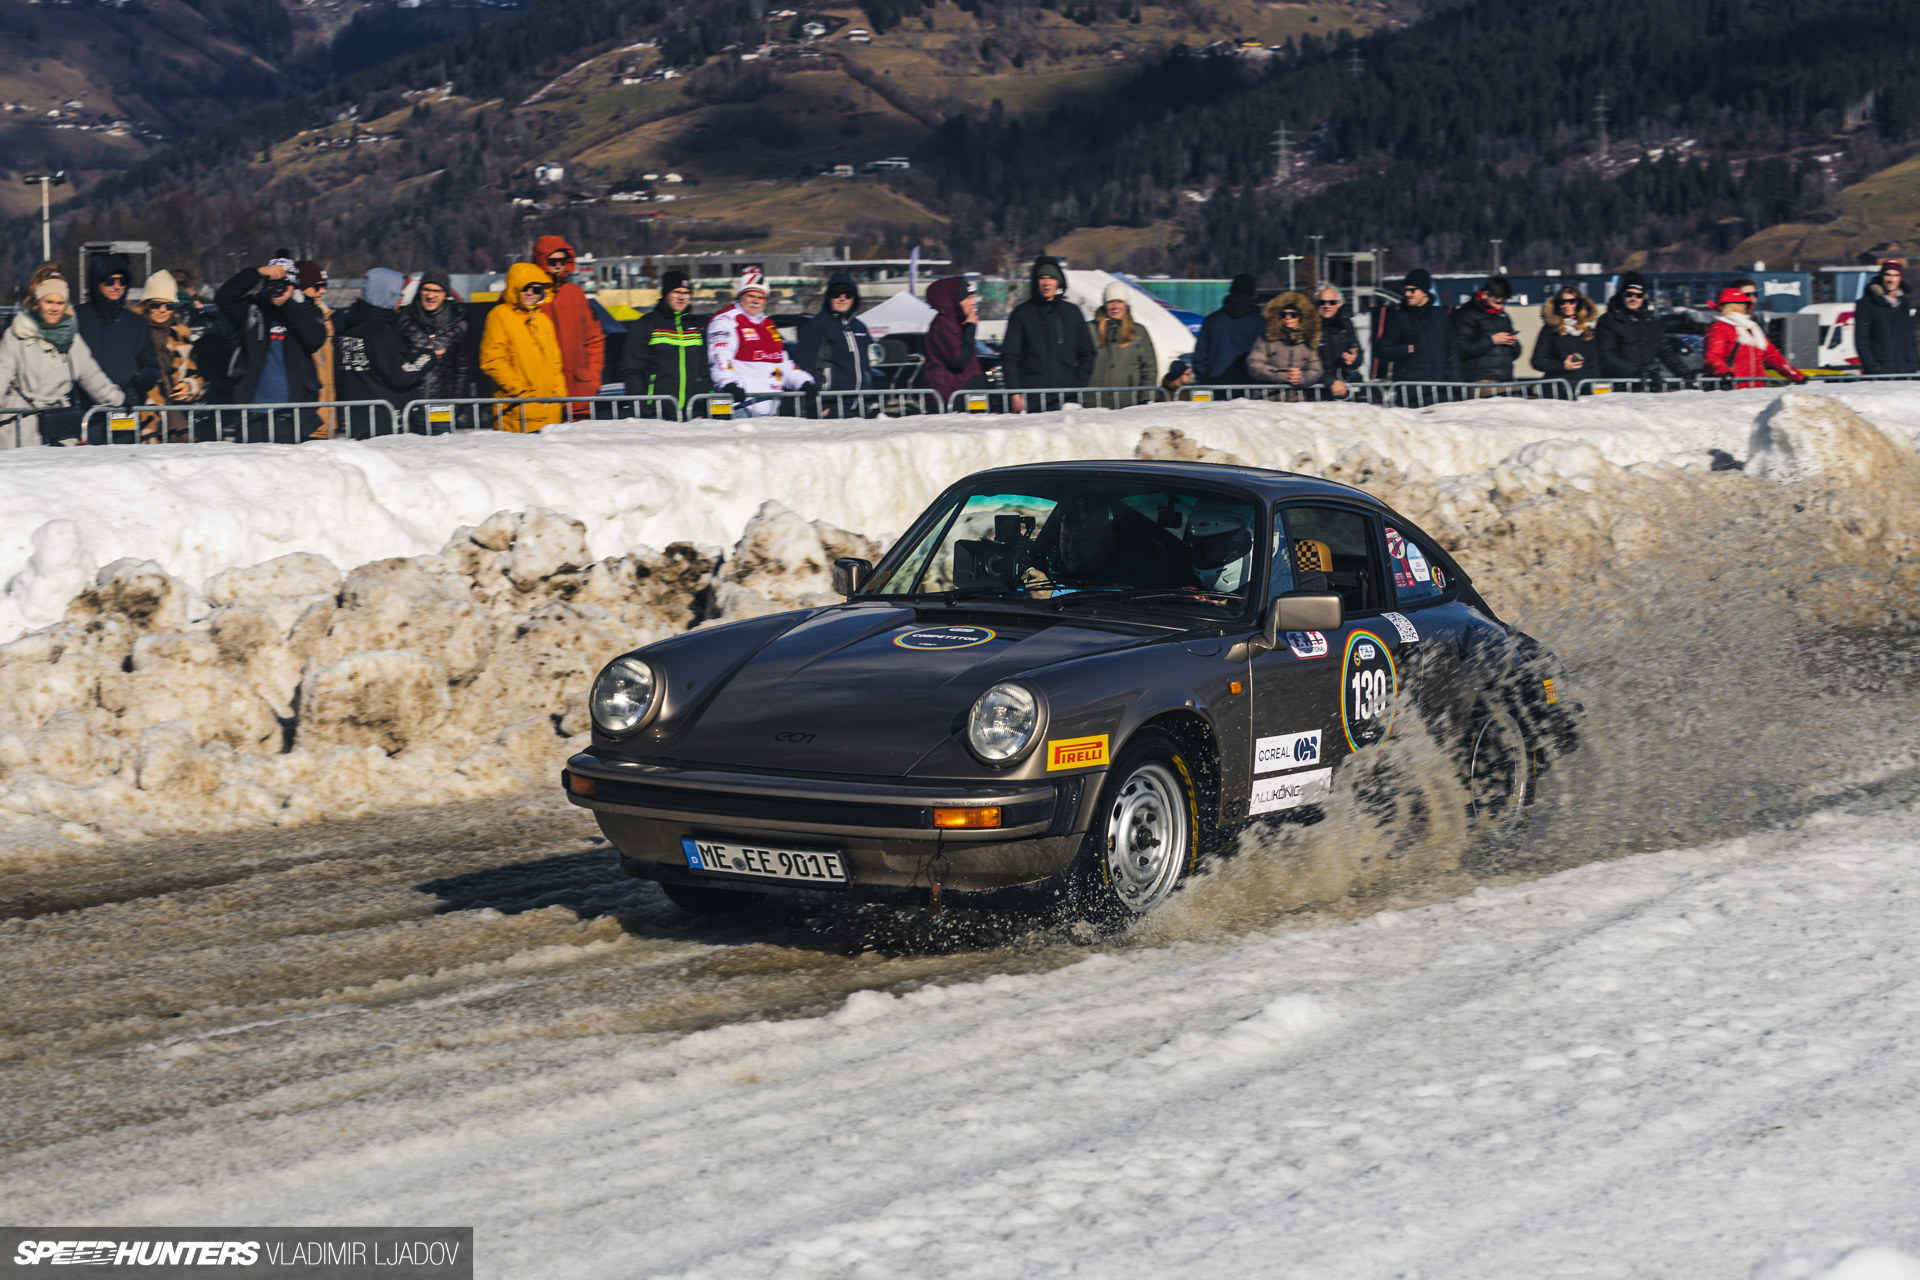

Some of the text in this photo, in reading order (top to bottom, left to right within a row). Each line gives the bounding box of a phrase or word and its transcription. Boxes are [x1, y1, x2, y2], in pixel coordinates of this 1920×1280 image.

[1352, 669, 1386, 720] 130
[1054, 741, 1103, 764] PIRELLI
[691, 856, 699, 864] D
[698, 844, 844, 879] ME EE 901E
